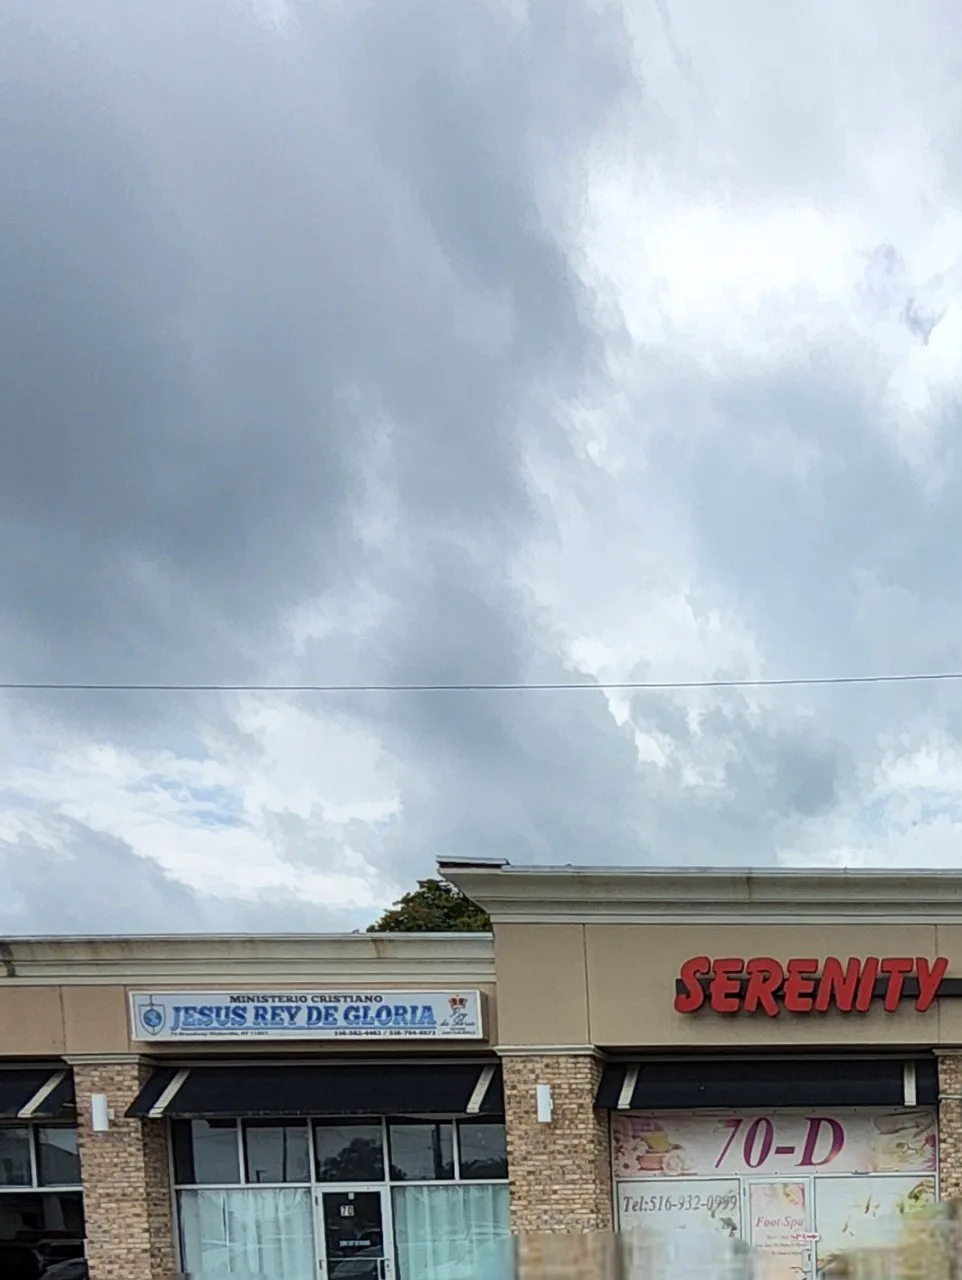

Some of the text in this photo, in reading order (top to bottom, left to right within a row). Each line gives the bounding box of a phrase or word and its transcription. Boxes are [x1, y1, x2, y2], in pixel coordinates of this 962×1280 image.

[229, 995, 383, 1004] MINISTERIO CRISTIANO
[674, 956, 949, 1017] SERENITY
[170, 1005, 437, 1032] JESUS REY DE GLORIA
[714, 1116, 846, 1169] 70-D
[755, 1215, 804, 1230] Foot Spa
